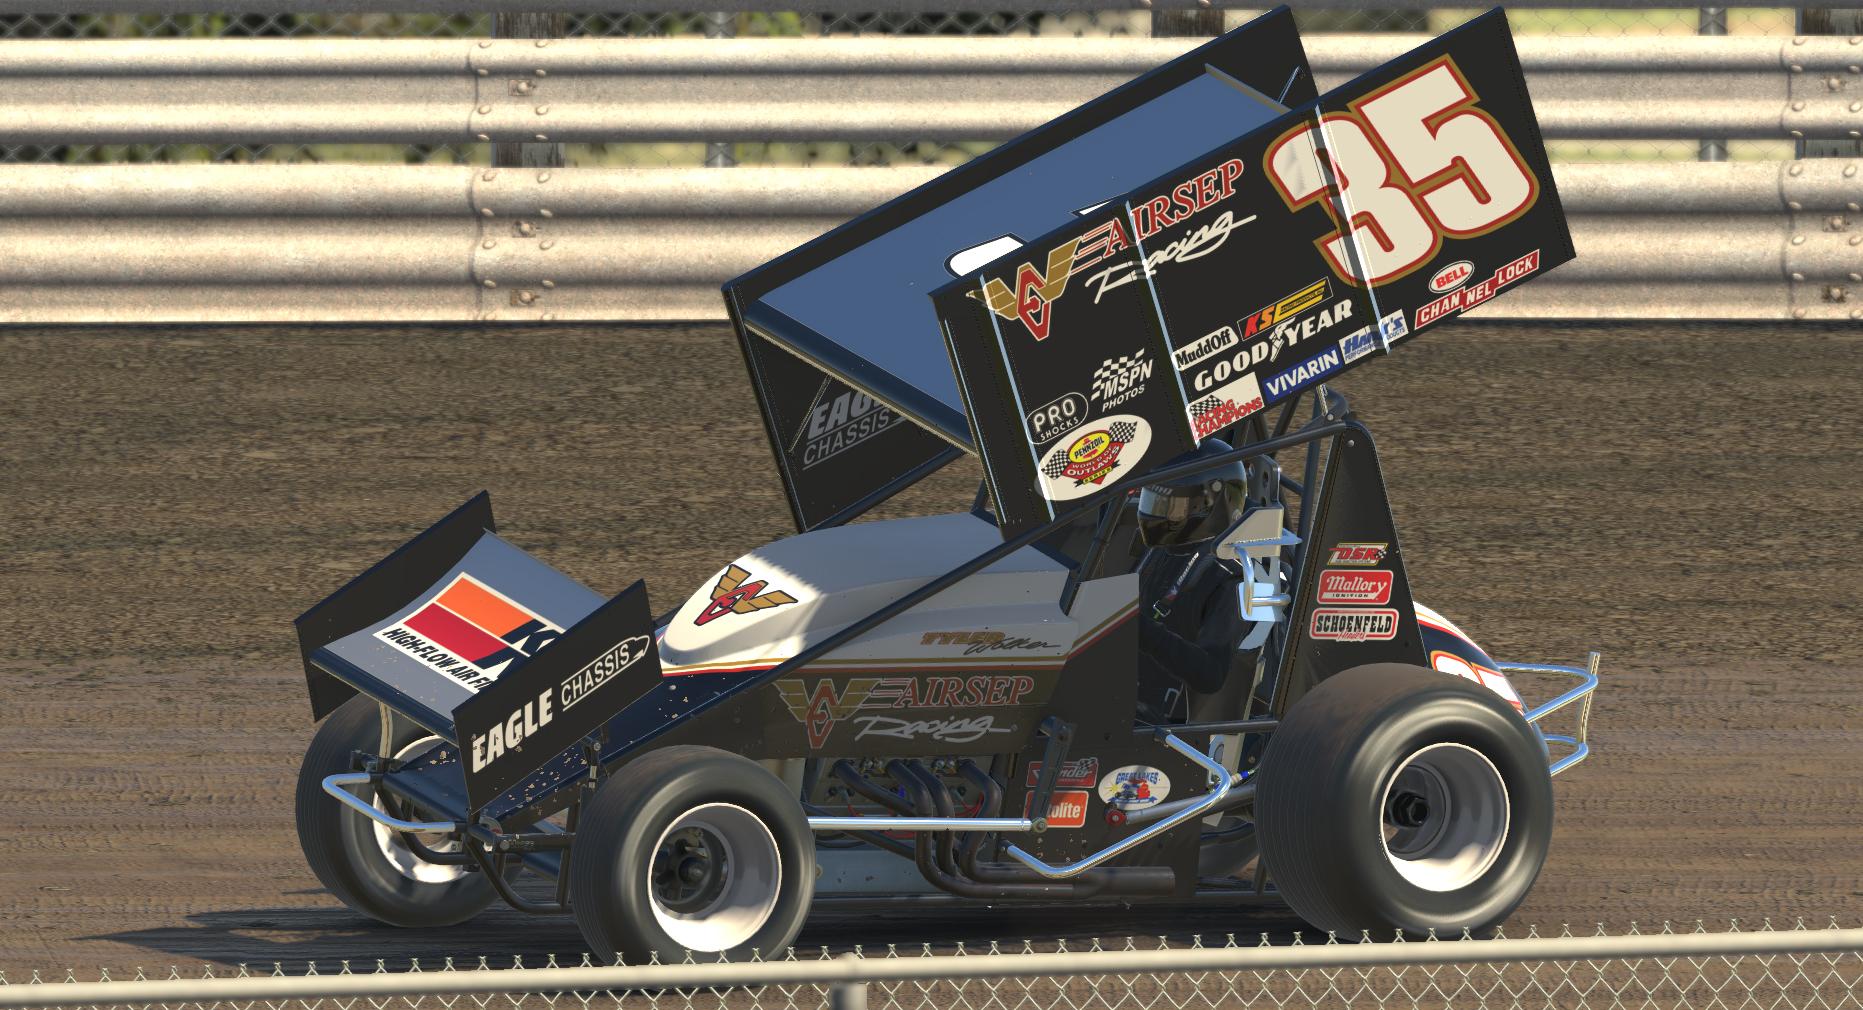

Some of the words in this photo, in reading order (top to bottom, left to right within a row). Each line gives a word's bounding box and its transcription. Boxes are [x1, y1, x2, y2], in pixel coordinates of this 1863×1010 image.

[1263, 53, 1541, 288] 35
[1103, 159, 1245, 258] AIRSEP
[1085, 211, 1257, 304] Racing
[1435, 266, 1469, 289] BELL
[1244, 280, 1327, 338] KSE
[1175, 328, 1232, 367] MuddOff
[1103, 359, 1153, 400] MSPN
[1266, 349, 1340, 396] VIVARIN
[807, 390, 884, 440] EAG
[1032, 397, 1077, 434] PRO
[1102, 383, 1145, 412] PHOTOS
[1194, 396, 1264, 438] HAMPIONS
[1195, 398, 1236, 425] ACING
[803, 408, 890, 465] CHASSIS
[1040, 416, 1079, 441] SHOCKS
[1074, 436, 1105, 460] PENNZOIL
[1066, 445, 1121, 476] OUTLAWS
[1326, 575, 1388, 595] Mallory
[1316, 615, 1393, 633] SCHOENFELD
[382, 628, 459, 671] HIGH-FLOW
[446, 665, 481, 683] AIR
[468, 676, 493, 690] FI
[562, 644, 630, 706] CHASSIS
[893, 676, 1034, 708] AIRSEP
[472, 688, 553, 773] EAGLE
[853, 715, 1012, 743] Racing
